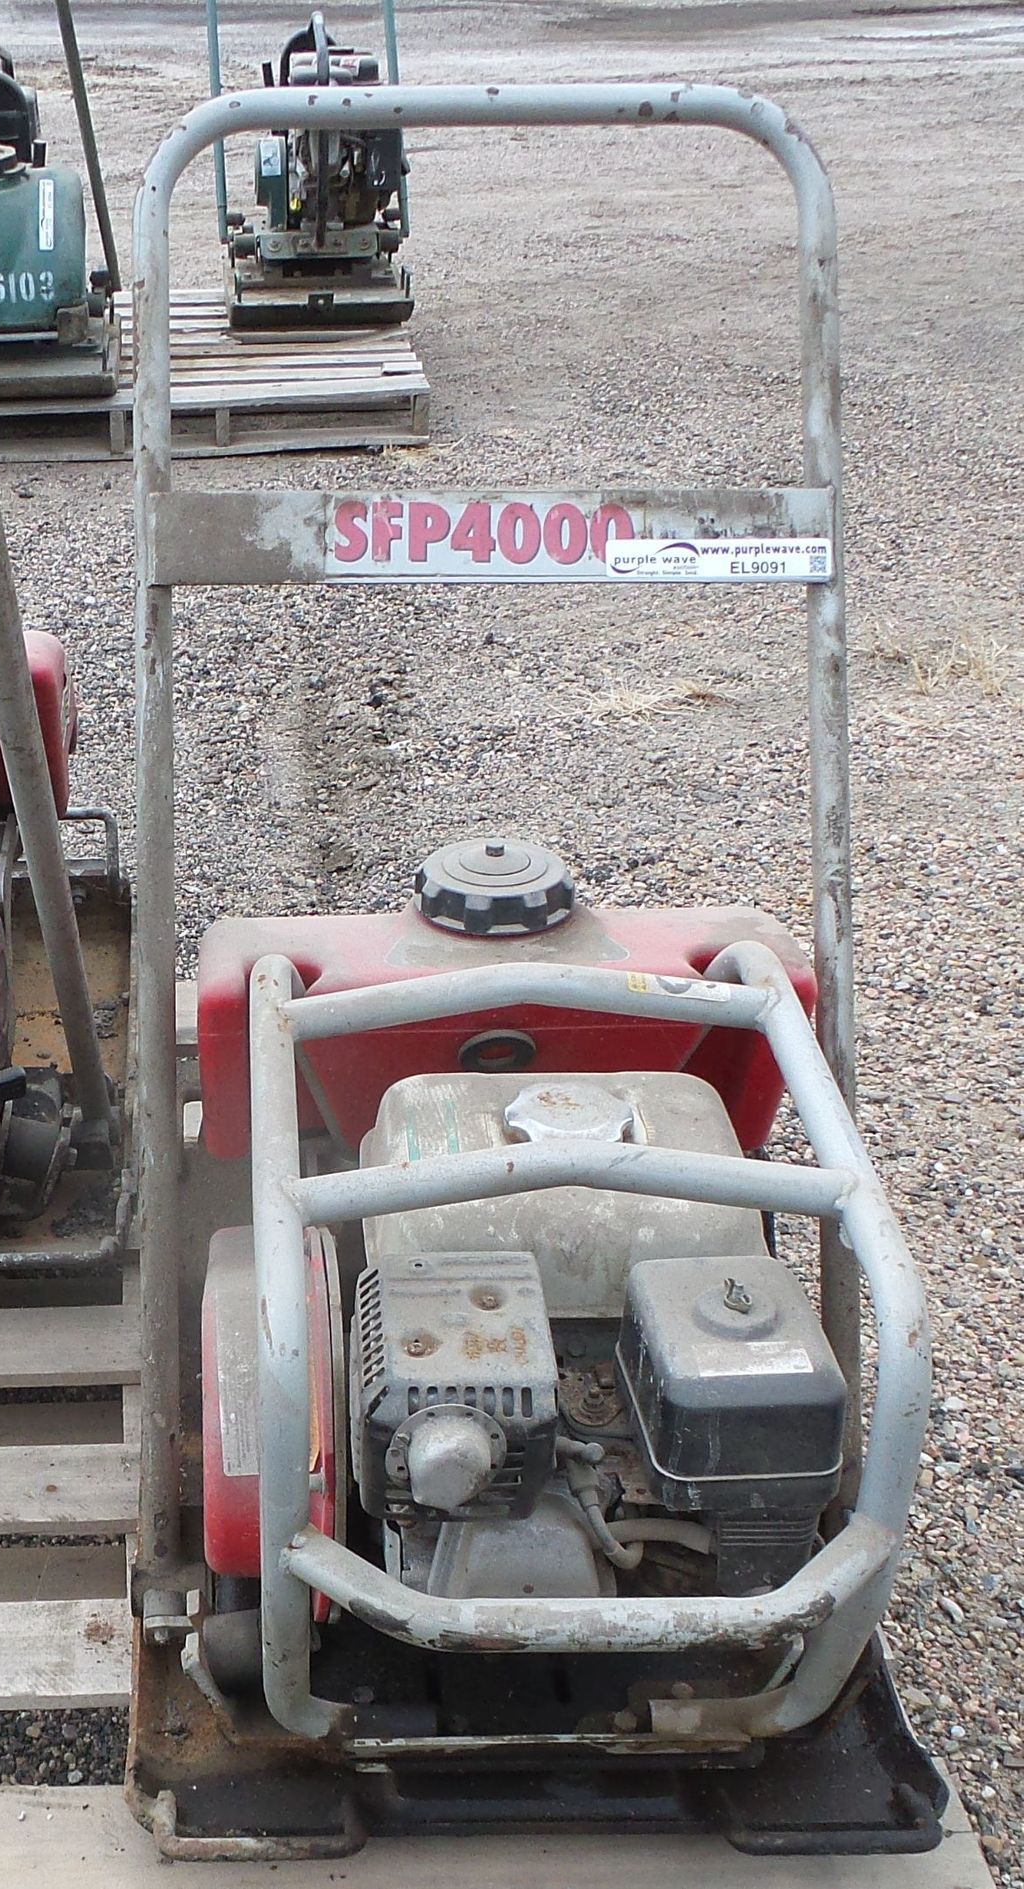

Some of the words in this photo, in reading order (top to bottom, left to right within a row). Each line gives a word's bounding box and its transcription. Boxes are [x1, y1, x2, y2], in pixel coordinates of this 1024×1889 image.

[334, 501, 636, 565] SFP4000
[700, 544, 826, 557] www.purplewave.com
[614, 555, 657, 566] purple
[662, 556, 697, 565] wave
[730, 561, 787, 574] EL9091
